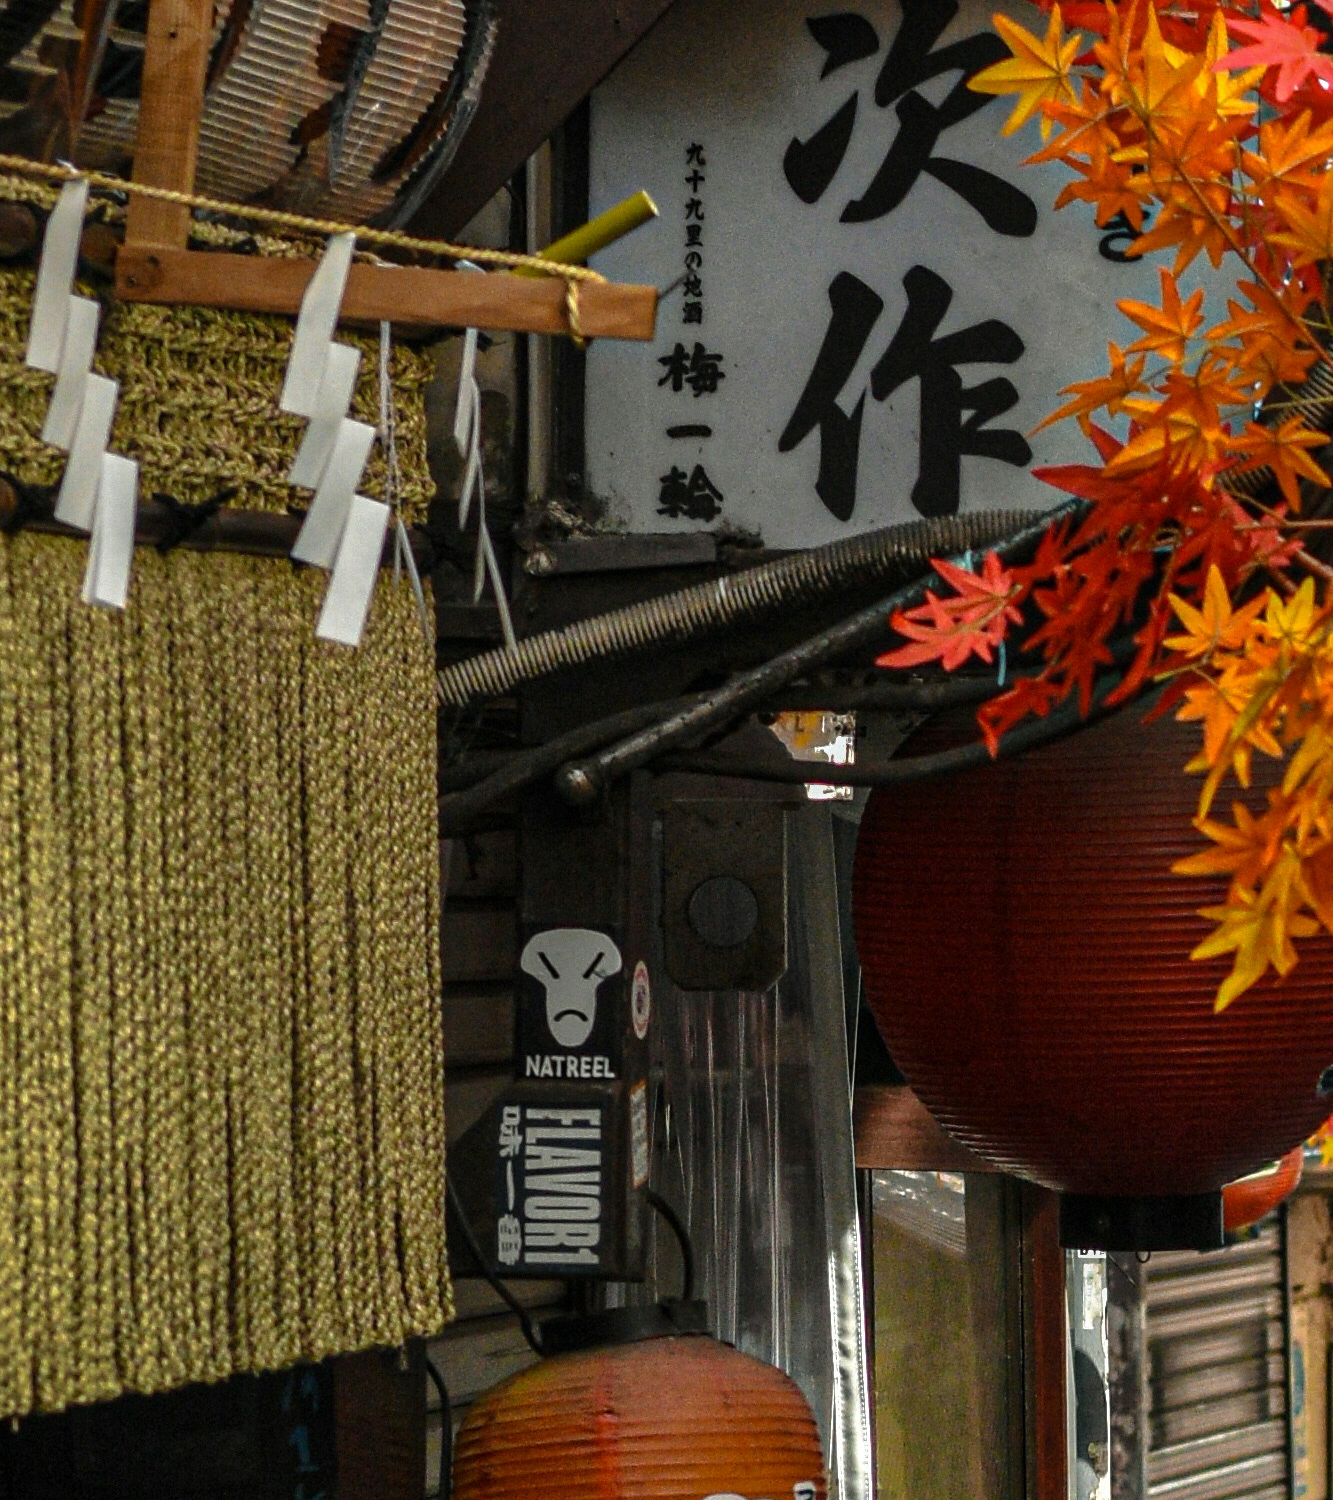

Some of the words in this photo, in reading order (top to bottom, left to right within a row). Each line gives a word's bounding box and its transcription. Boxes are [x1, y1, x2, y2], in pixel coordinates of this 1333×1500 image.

[682, 142, 706, 325] 九十九里の地酒
[525, 1054, 616, 1080] NATREEL
[524, 1106, 602, 1266] FLAVOR1
